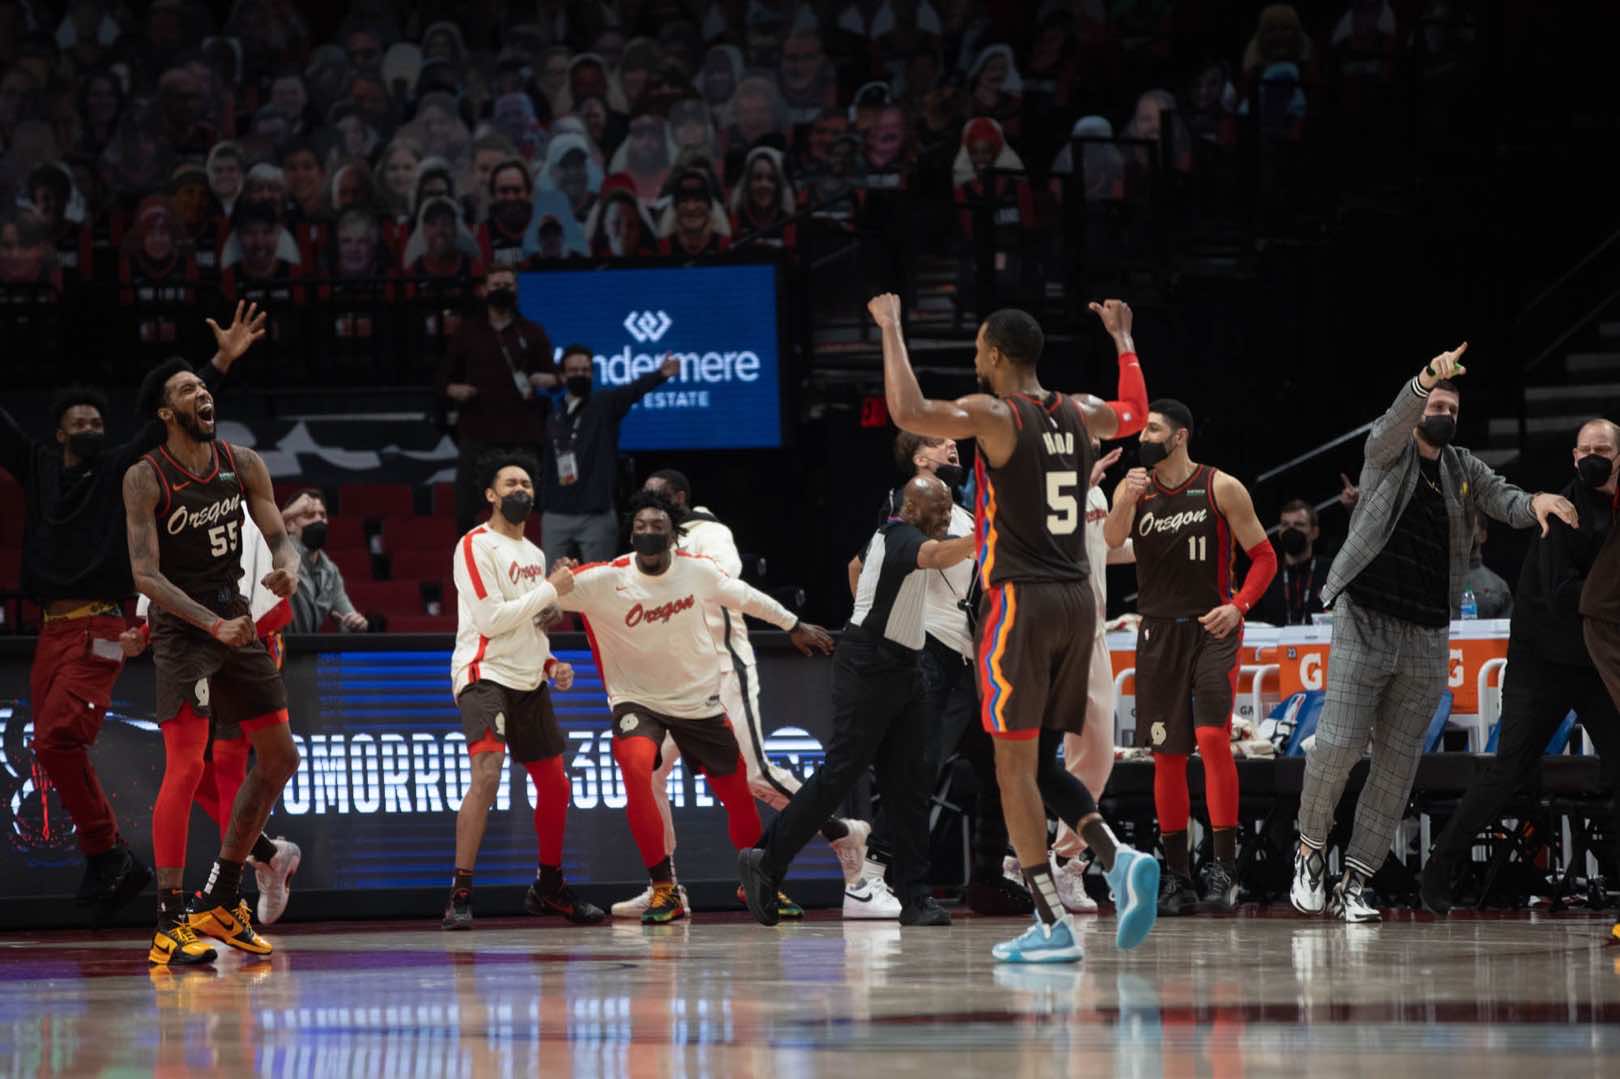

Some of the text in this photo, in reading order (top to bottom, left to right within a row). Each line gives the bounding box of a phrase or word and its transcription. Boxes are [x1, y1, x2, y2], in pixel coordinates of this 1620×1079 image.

[643, 391, 709, 408] ESTATE
[167, 493, 240, 535] Oregon
[1045, 471, 1078, 535] 5
[208, 520, 239, 557] 55
[1138, 508, 1208, 537] Oregon
[1188, 535, 1207, 561] 11
[624, 594, 695, 628] Oregon
[270, 732, 511, 815] OMORRO
